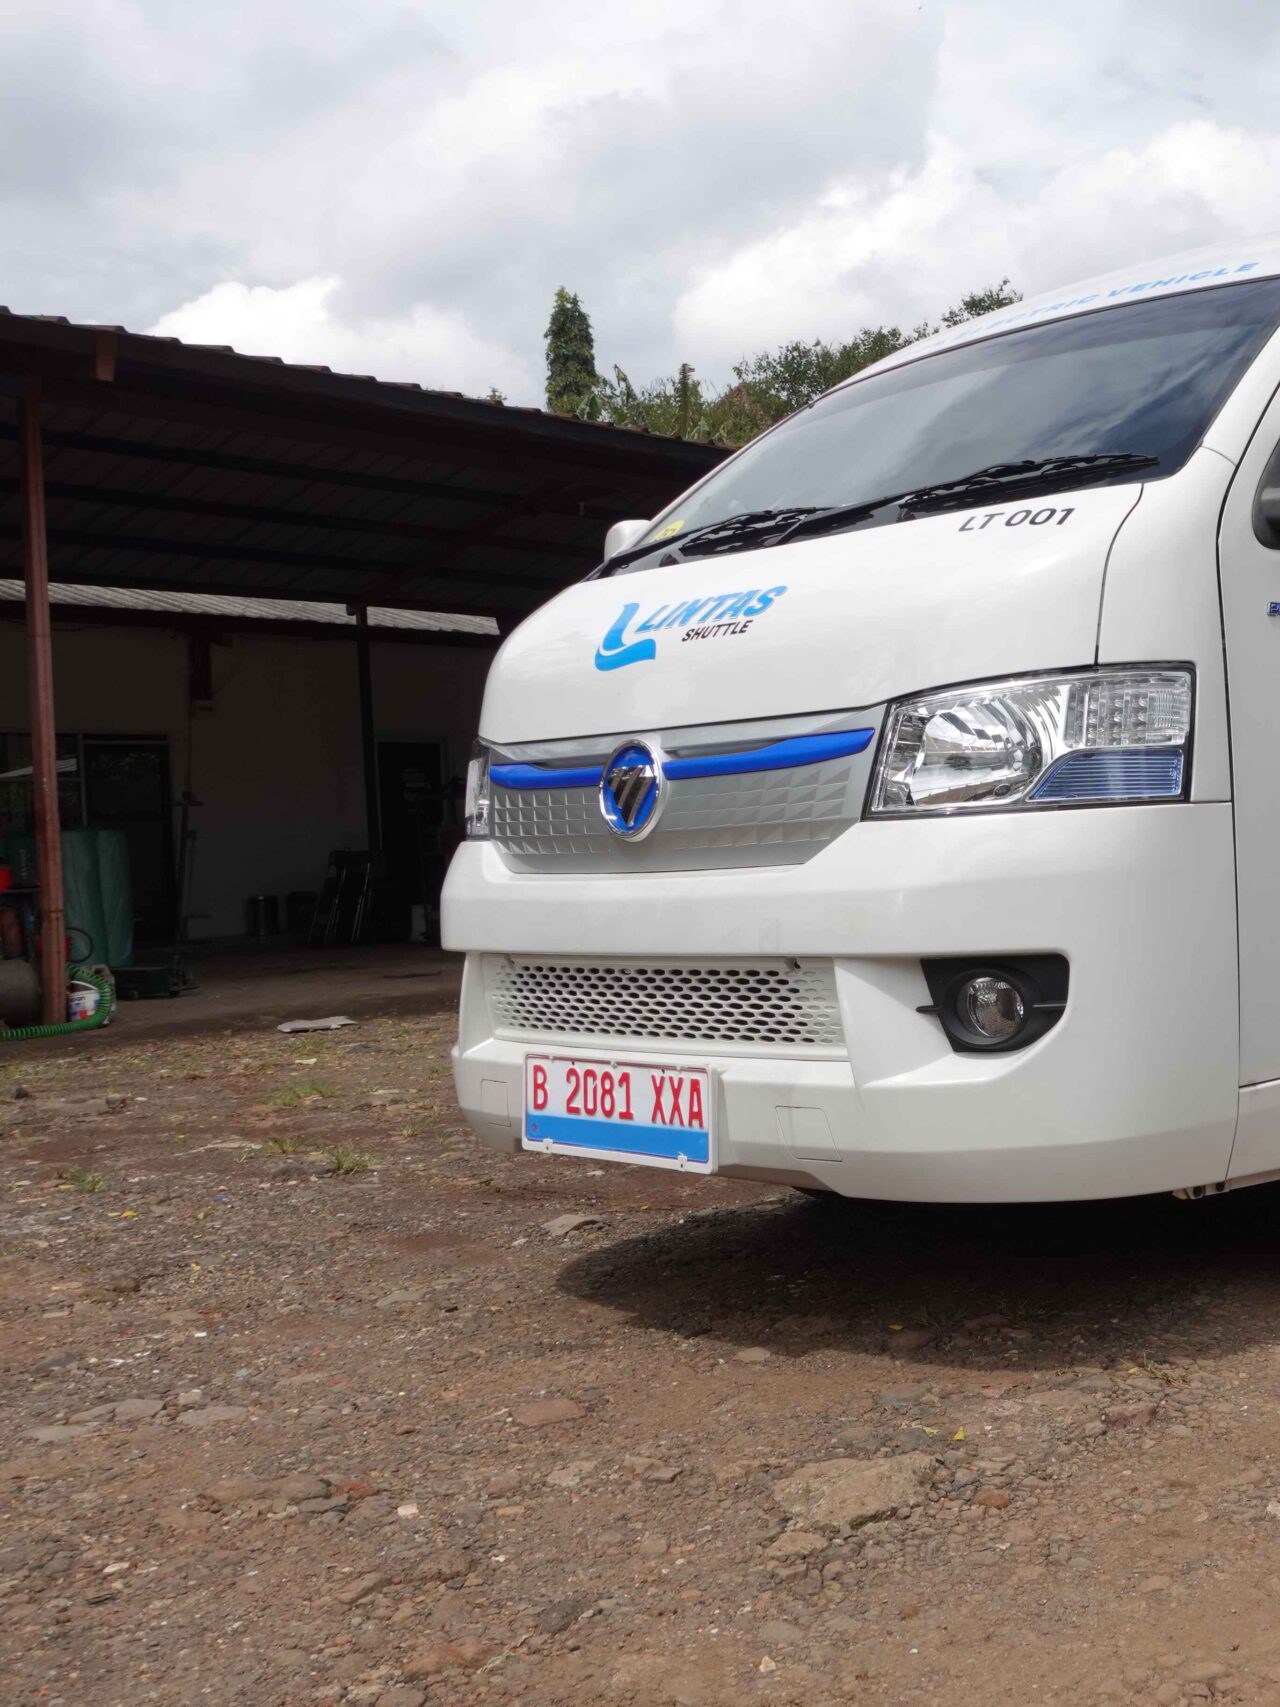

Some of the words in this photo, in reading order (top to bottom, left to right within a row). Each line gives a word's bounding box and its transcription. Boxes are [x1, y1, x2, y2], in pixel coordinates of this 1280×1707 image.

[1107, 262, 1259, 298] VEHICLE
[958, 512, 1005, 532] LT
[1004, 508, 1076, 527] 001
[634, 585, 788, 634] LINTAS
[681, 619, 754, 642] SHUTTLE
[533, 1064, 549, 1111] B
[566, 1067, 634, 1122] 2081
[651, 1073, 705, 1130] XXA
